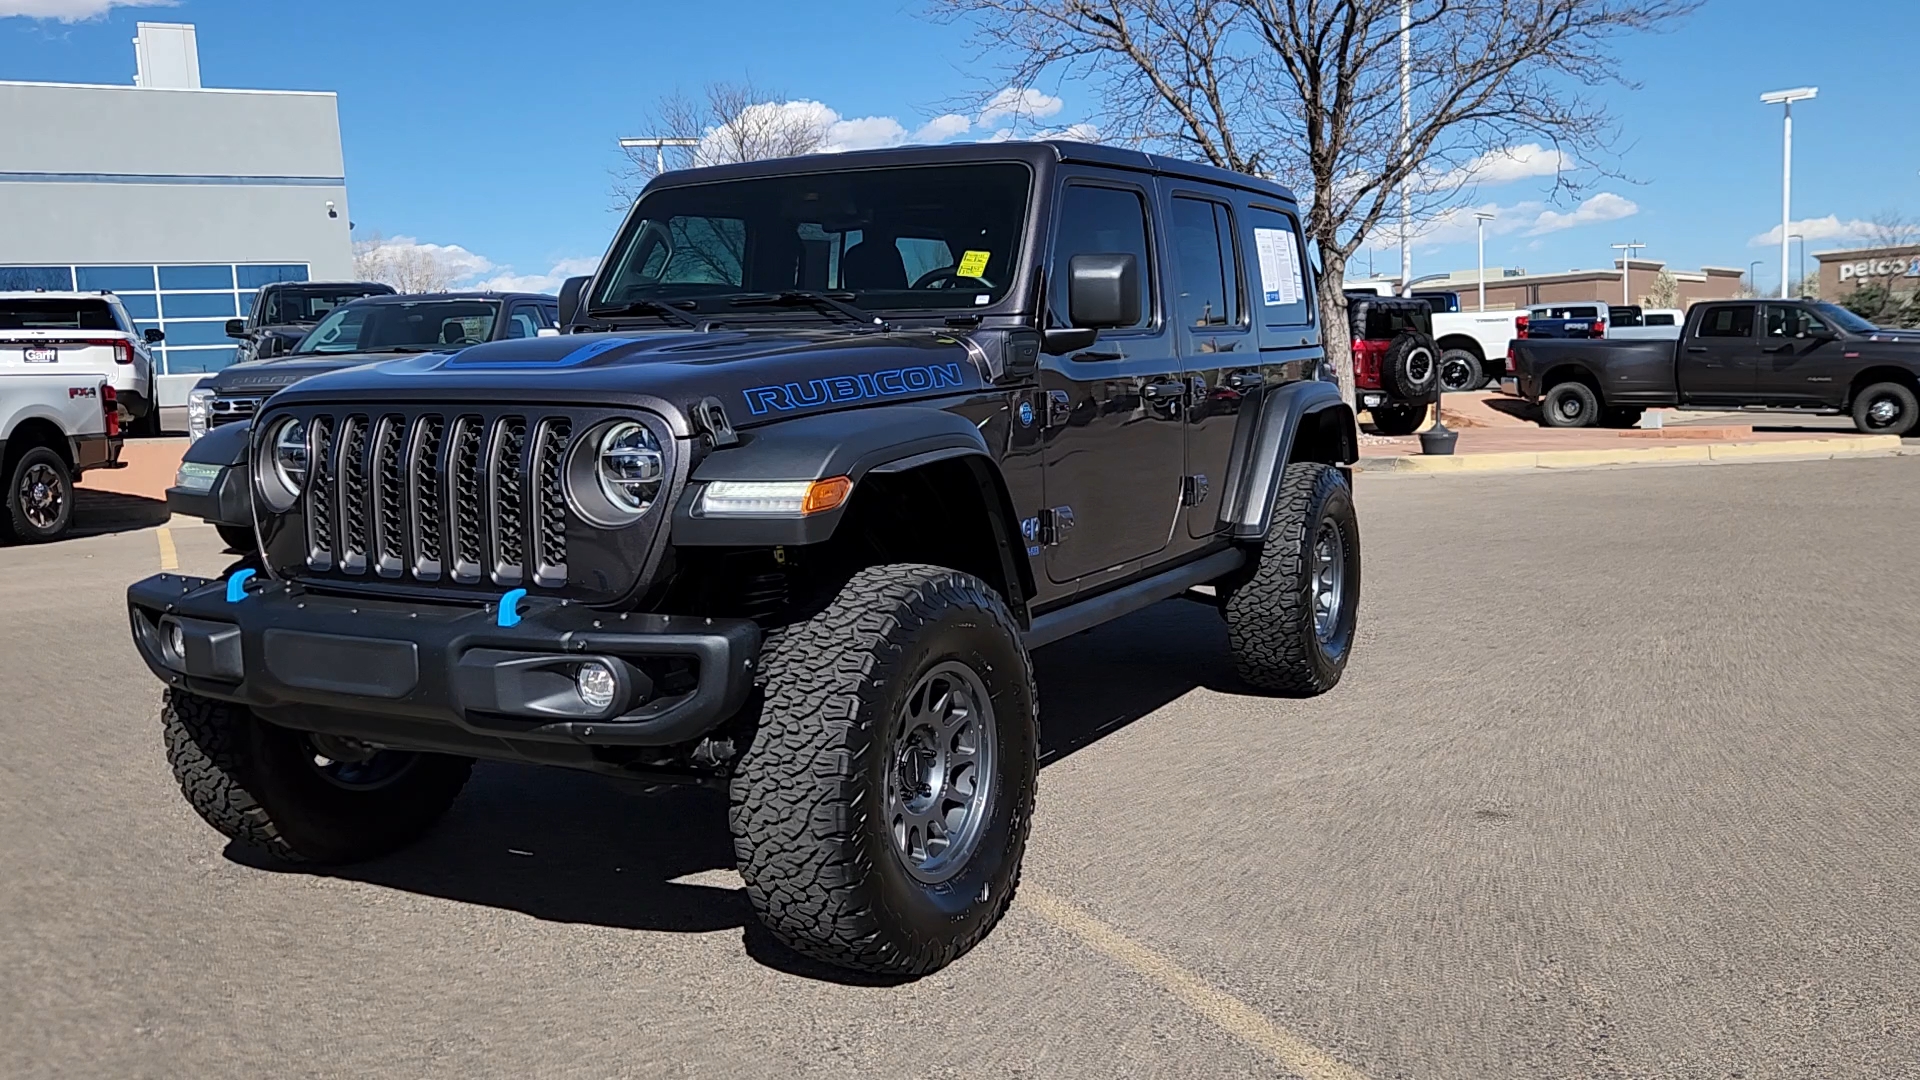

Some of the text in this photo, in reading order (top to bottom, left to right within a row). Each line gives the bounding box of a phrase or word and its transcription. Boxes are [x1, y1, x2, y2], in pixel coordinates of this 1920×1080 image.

[1839, 258, 1907, 282] petco
[68, 387, 97, 399] FX4
[742, 363, 964, 415] RUBICON
